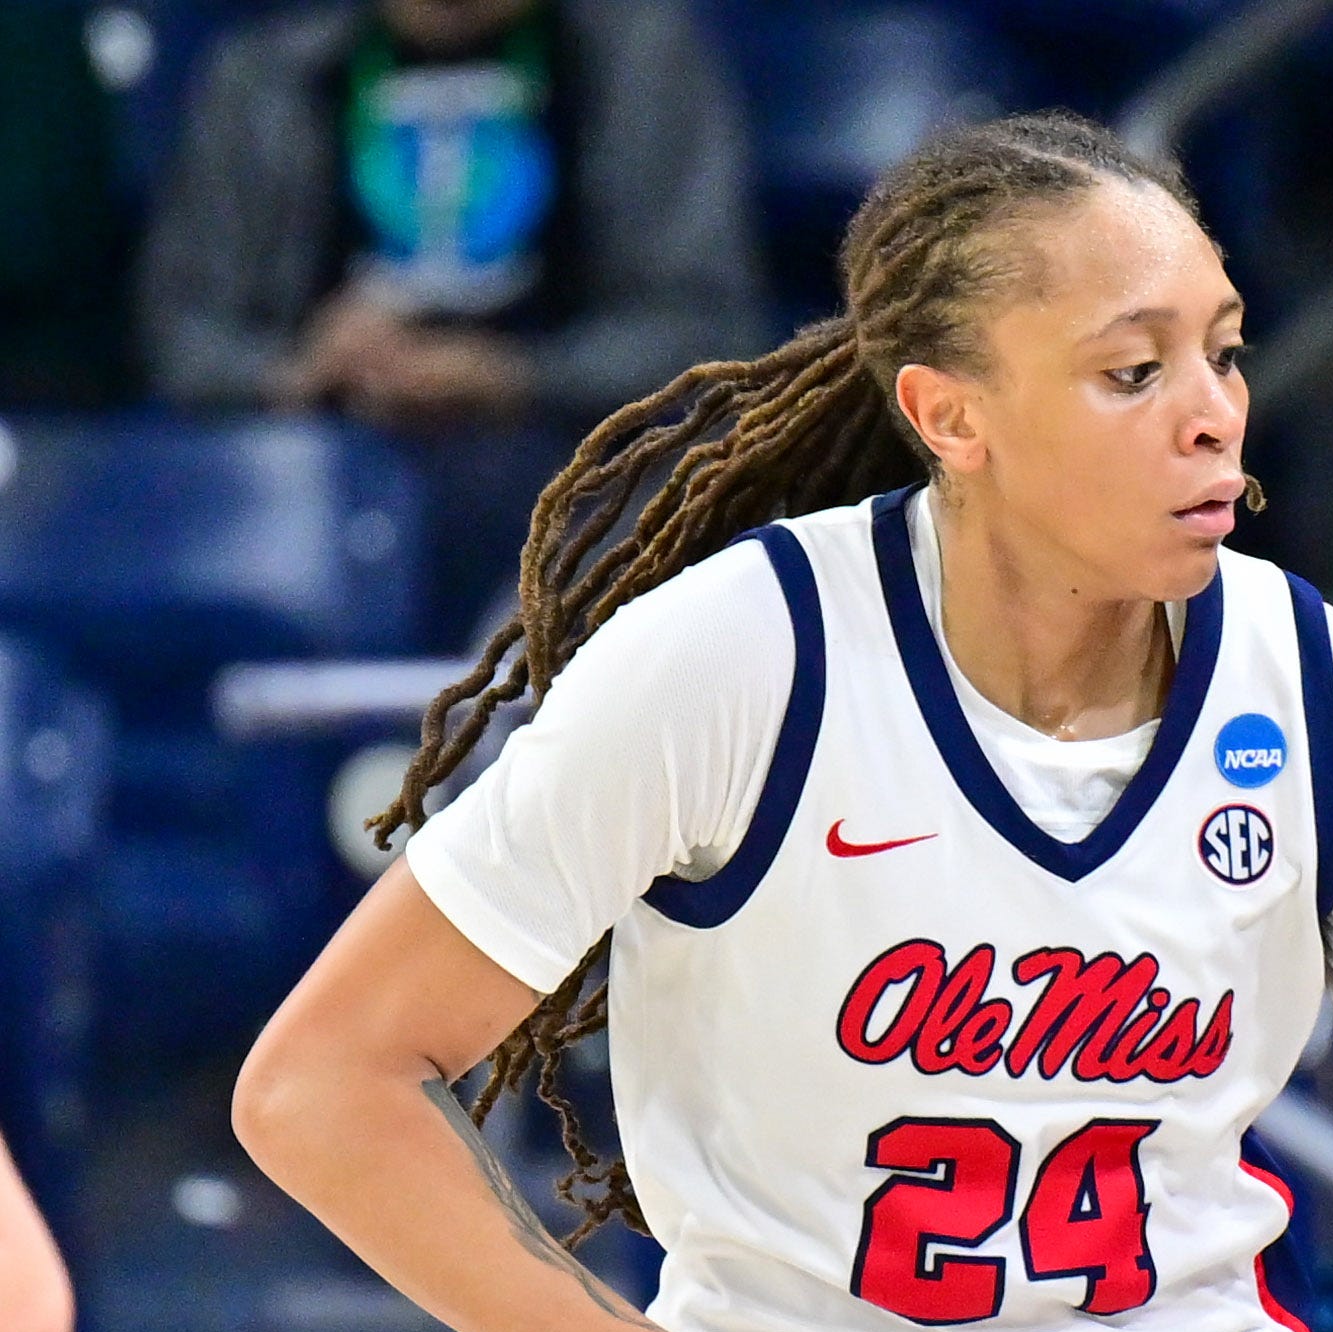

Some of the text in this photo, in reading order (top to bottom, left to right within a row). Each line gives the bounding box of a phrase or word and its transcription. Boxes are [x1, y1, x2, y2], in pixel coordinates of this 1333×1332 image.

[1224, 748, 1283, 769] NCAA
[1204, 808, 1270, 880] SEC
[837, 938, 1235, 1084] Ole Miss
[849, 1115, 1161, 1326] 24
